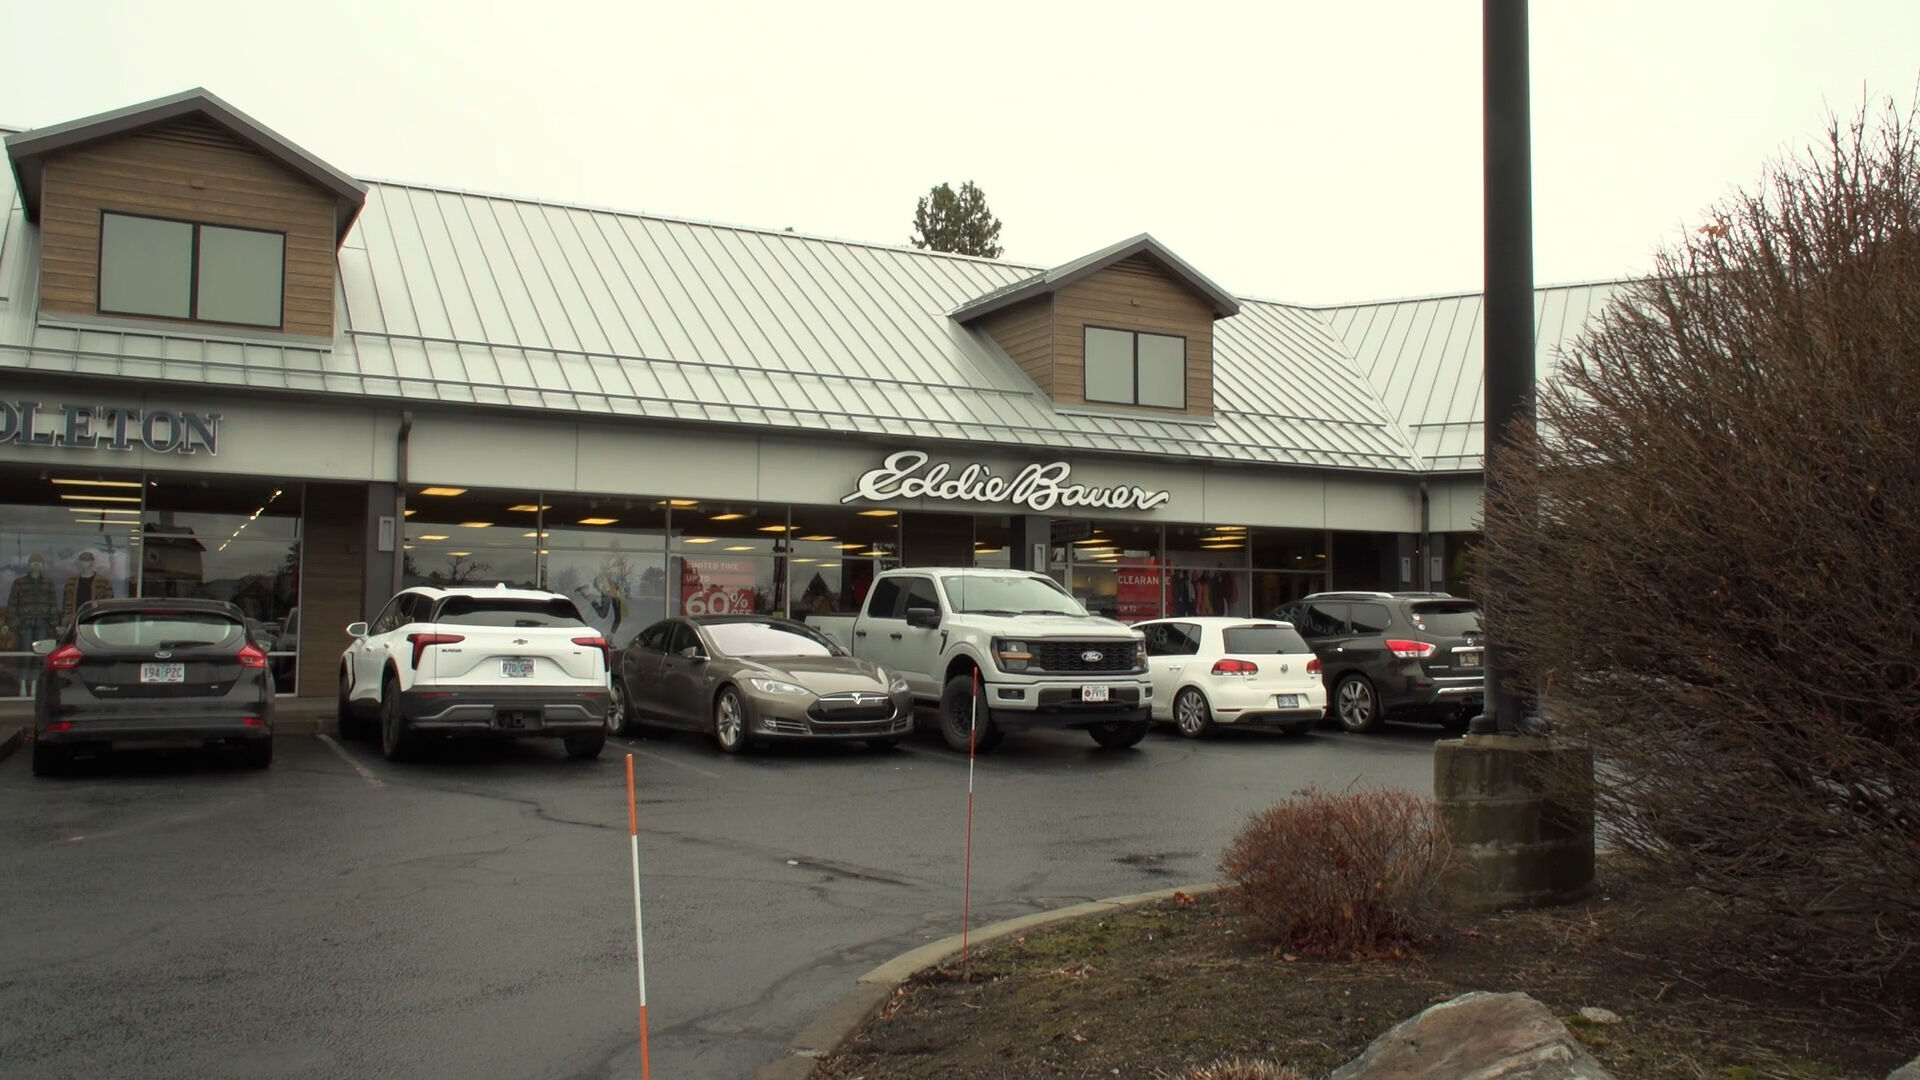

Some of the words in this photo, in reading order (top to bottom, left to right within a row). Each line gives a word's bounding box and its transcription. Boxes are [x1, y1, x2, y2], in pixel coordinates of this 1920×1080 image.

[841, 450, 1013, 504] Eddie
[1012, 461, 1170, 511] Bauer
[1118, 576, 1171, 585] CLEARANE
